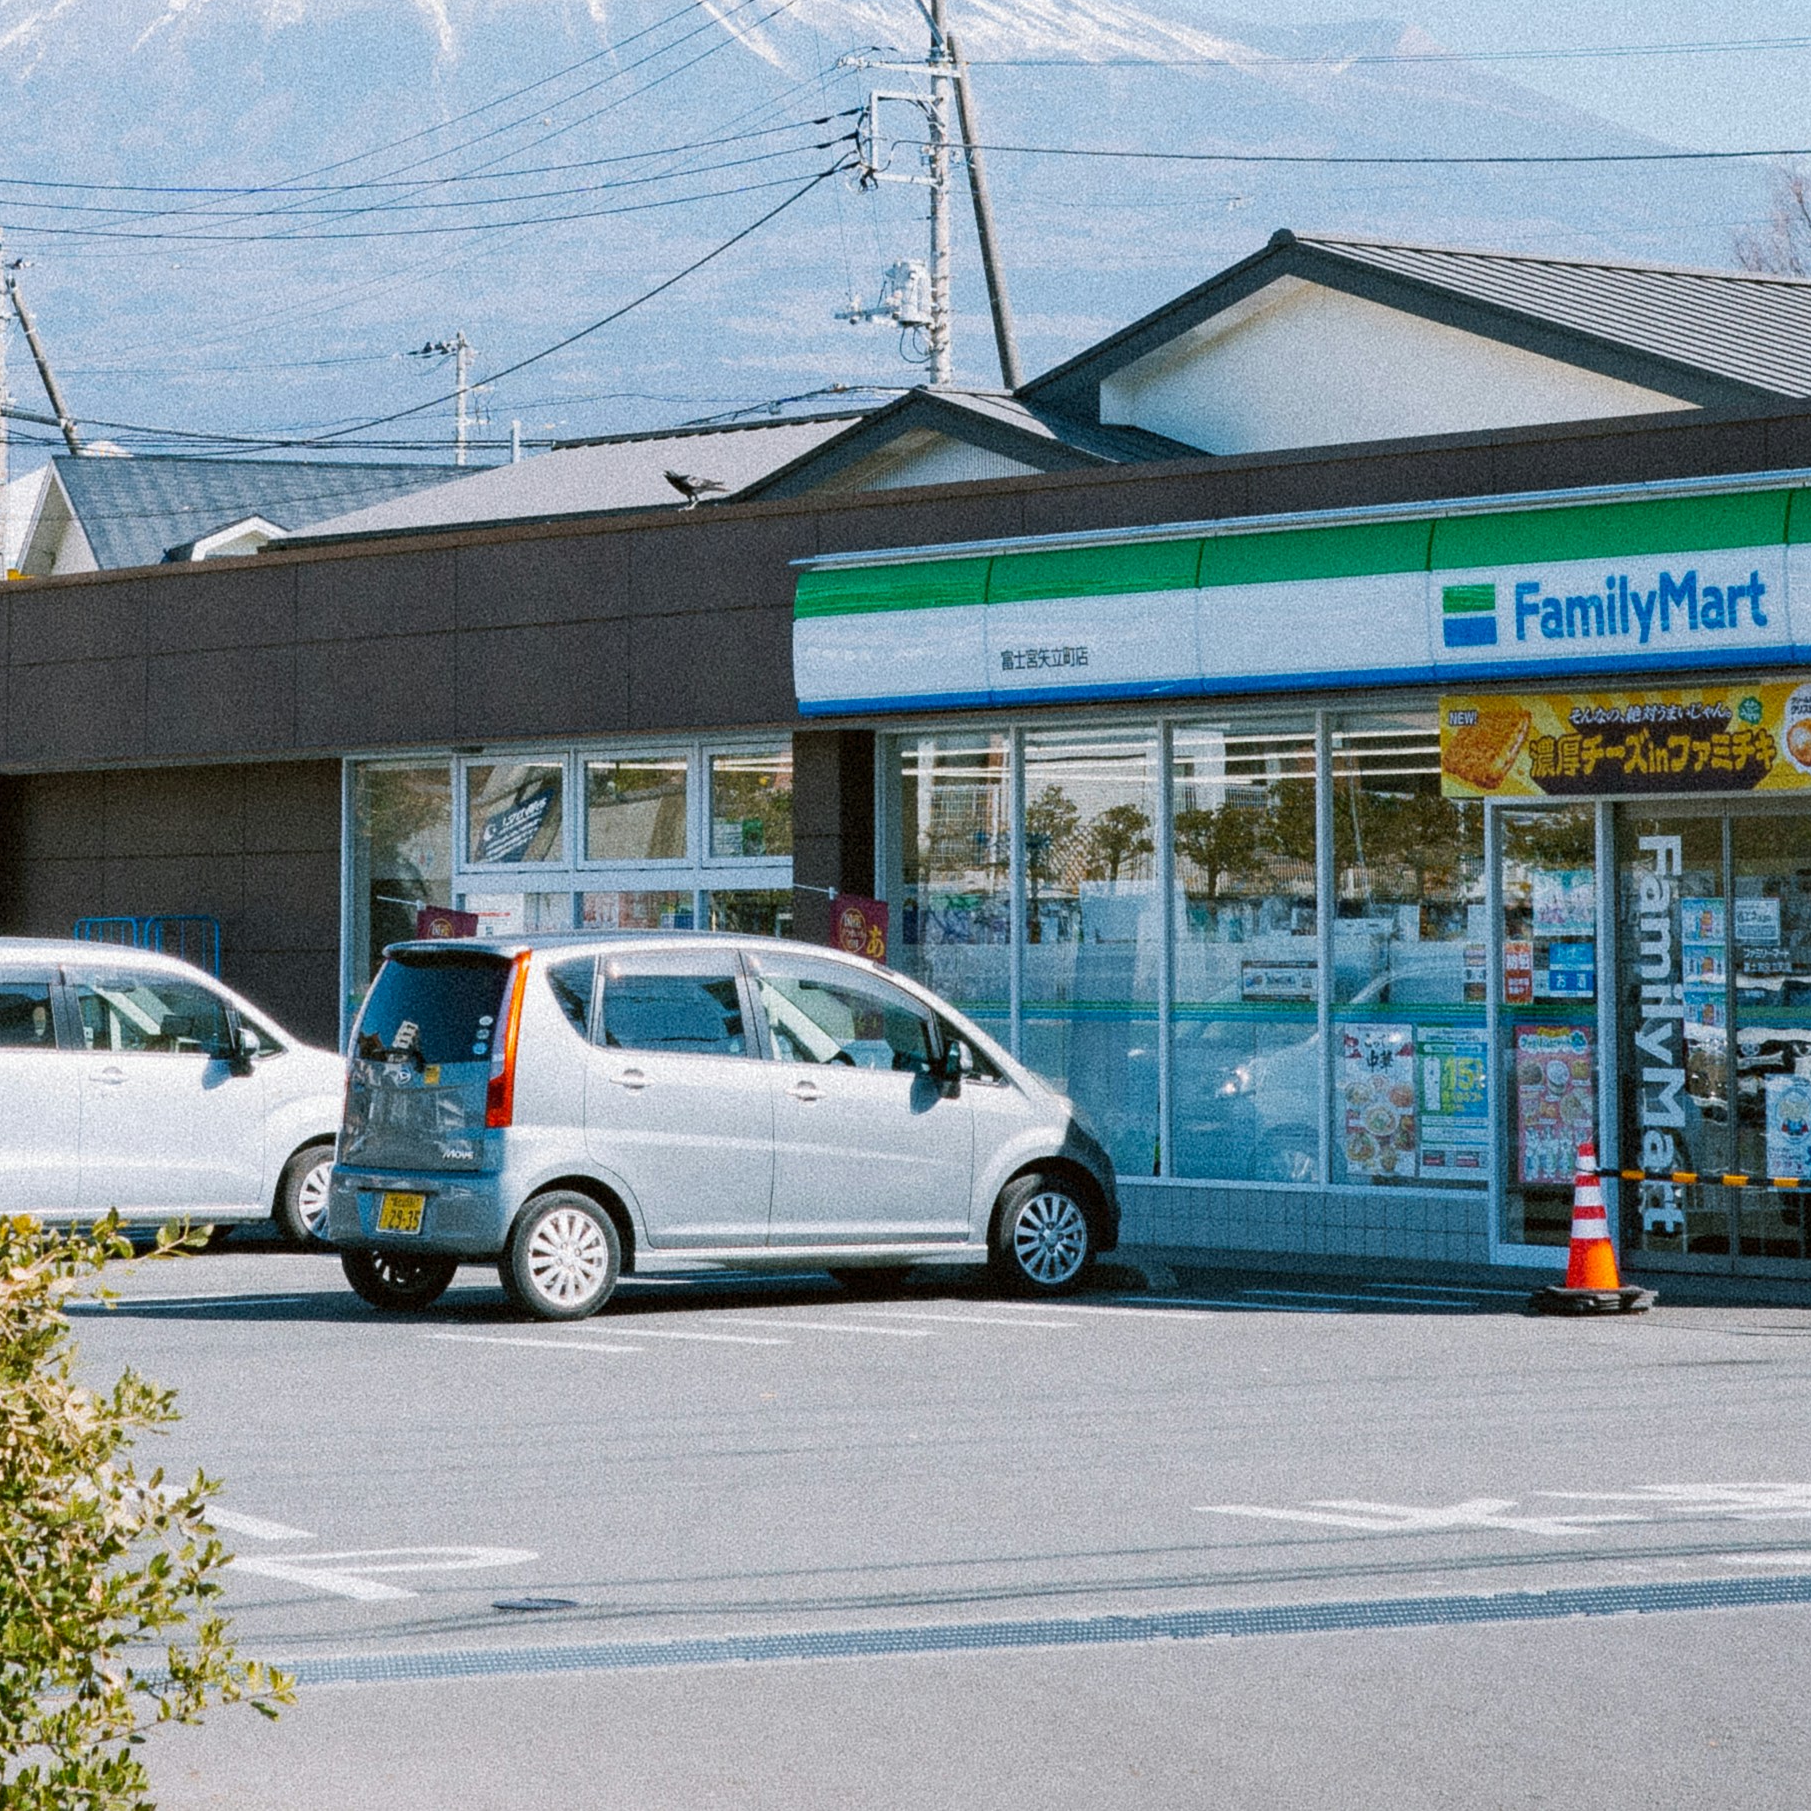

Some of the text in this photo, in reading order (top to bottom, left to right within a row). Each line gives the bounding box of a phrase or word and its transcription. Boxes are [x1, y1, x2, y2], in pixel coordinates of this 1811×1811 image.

[1515, 571, 1768, 644] FamilyMart
[1001, 645, 1089, 671] 富士宮矢立町店
[1448, 710, 1478, 726] NEW!
[1569, 701, 1733, 725] そんなの、絶対うまいじゃん。
[1529, 728, 1777, 778] 濃厚チーズinファミチキ
[1635, 834, 1686, 1233] FamilyMart
